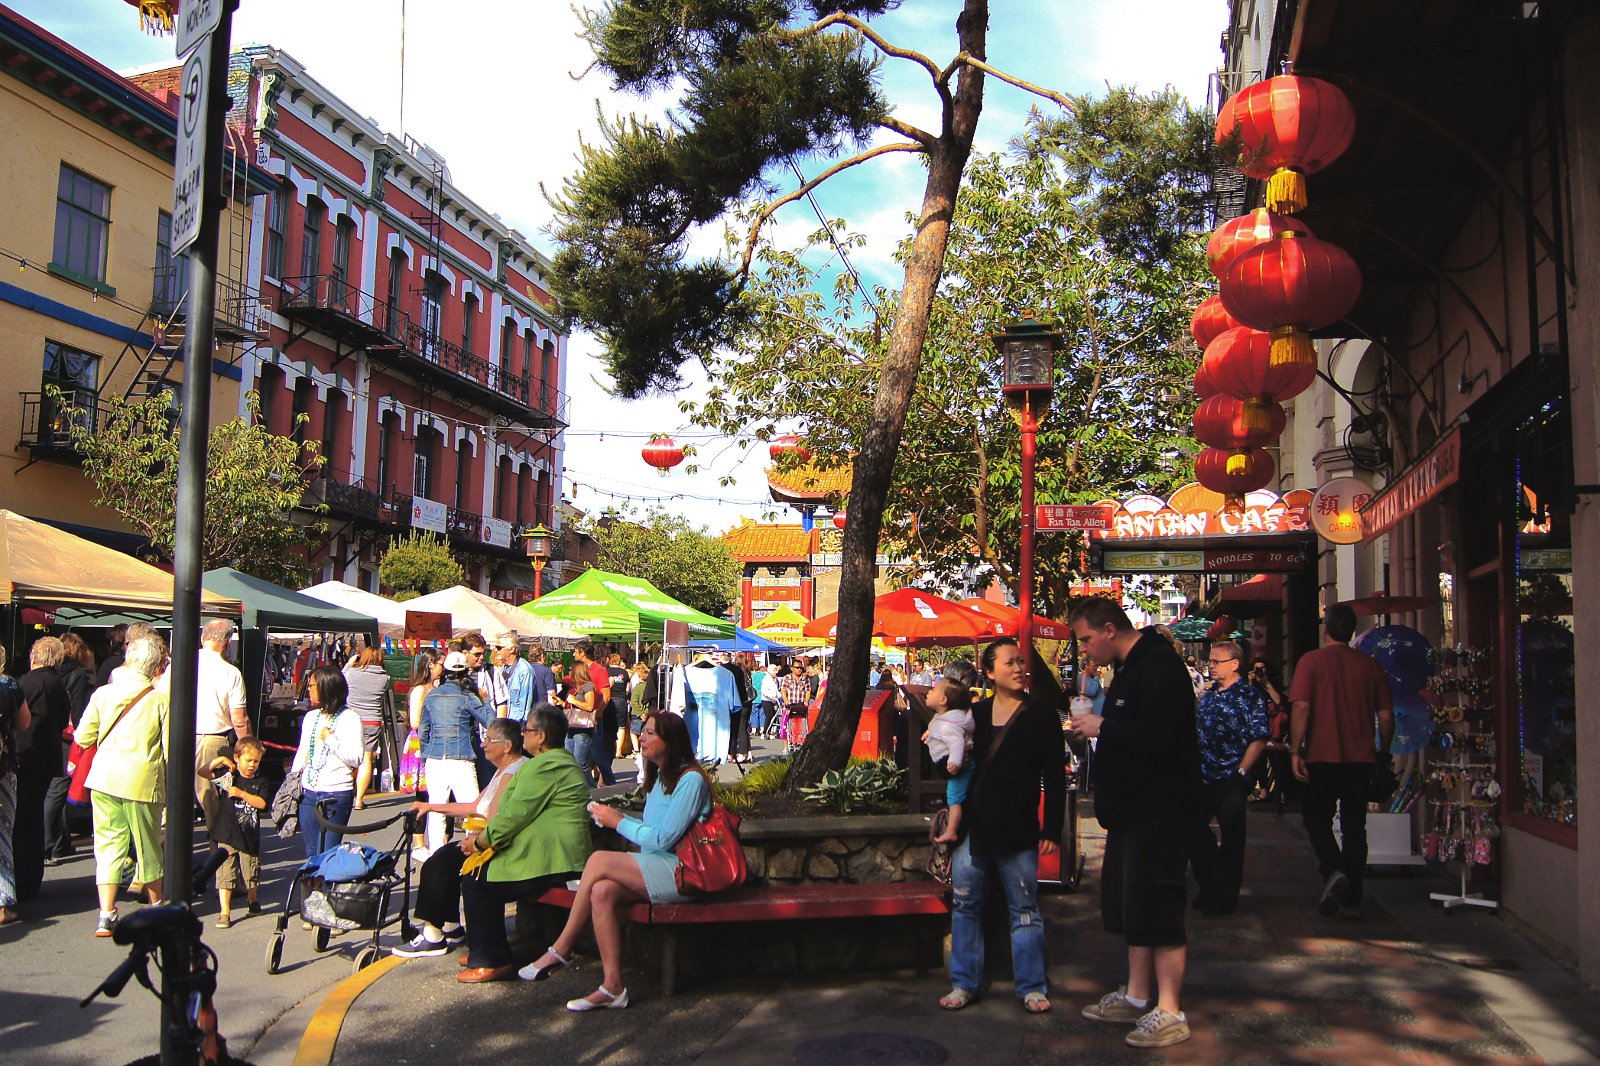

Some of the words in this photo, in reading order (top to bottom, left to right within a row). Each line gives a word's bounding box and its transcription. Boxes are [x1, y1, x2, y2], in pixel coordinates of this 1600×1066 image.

[1371, 489, 1400, 534] CATHAY
[1403, 455, 1438, 510] LIVING
[1048, 518, 1065, 527] Fan
[1067, 518, 1082, 527] Tan
[1082, 517, 1106, 529] Alley
[1220, 507, 1310, 535] CAFE
[1110, 555, 1158, 567] BUBBLE
[1172, 554, 1201, 566] TEA
[1208, 553, 1253, 569] NOODLES
[1270, 552, 1283, 563] TO
